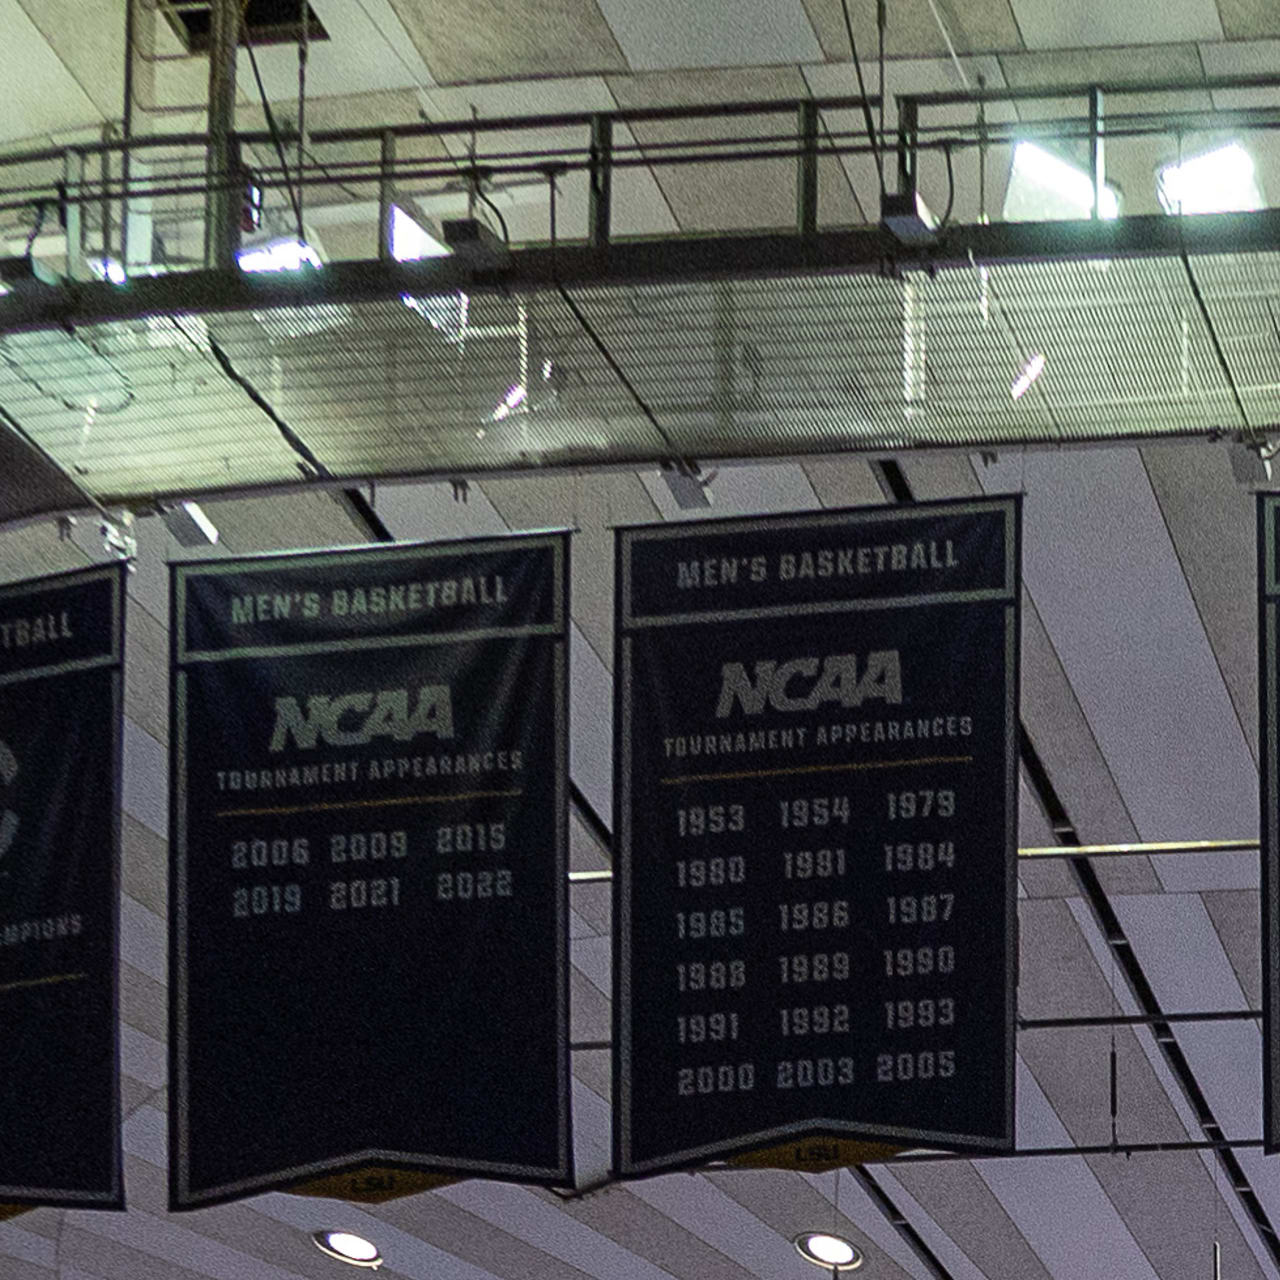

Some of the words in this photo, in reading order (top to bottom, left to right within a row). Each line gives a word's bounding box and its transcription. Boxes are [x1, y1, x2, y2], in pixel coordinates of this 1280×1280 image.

[677, 555, 767, 589] MEN'S
[779, 540, 959, 581] BASKETBALL
[231, 590, 322, 625] MEN'S
[331, 576, 508, 615] BASKETBALL
[715, 650, 903, 718] NCAA
[268, 685, 454, 752] NCAA
[665, 727, 807, 757] TOURNAMENT
[817, 716, 973, 745] APPEARANCES
[217, 758, 357, 791] TOURNAMENT
[370, 751, 524, 780] APPEARANCES
[678, 804, 745, 837] 1953
[780, 796, 850, 828] 1954
[887, 790, 956, 820] 1979
[232, 838, 309, 869] 2006
[331, 832, 407, 863] 2009
[437, 823, 507, 853] 2015
[676, 855, 745, 888] 1980
[885, 841, 954, 872] 1984
[233, 884, 301, 917] 2019
[330, 877, 400, 908] 2021
[437, 870, 513, 900] 2022
[676, 907, 744, 939] 1985
[779, 900, 850, 932] 1986
[886, 894, 955, 923] 1987
[676, 960, 746, 992] 1988
[779, 952, 850, 983] 1989
[884, 945, 955, 977] 1990
[677, 1012, 740, 1044] 1991
[780, 1005, 849, 1037] 1992
[885, 999, 955, 1030] 1993
[678, 1063, 755, 1096] 2000
[776, 1057, 854, 1089] 2003
[877, 1051, 956, 1083] 2005
